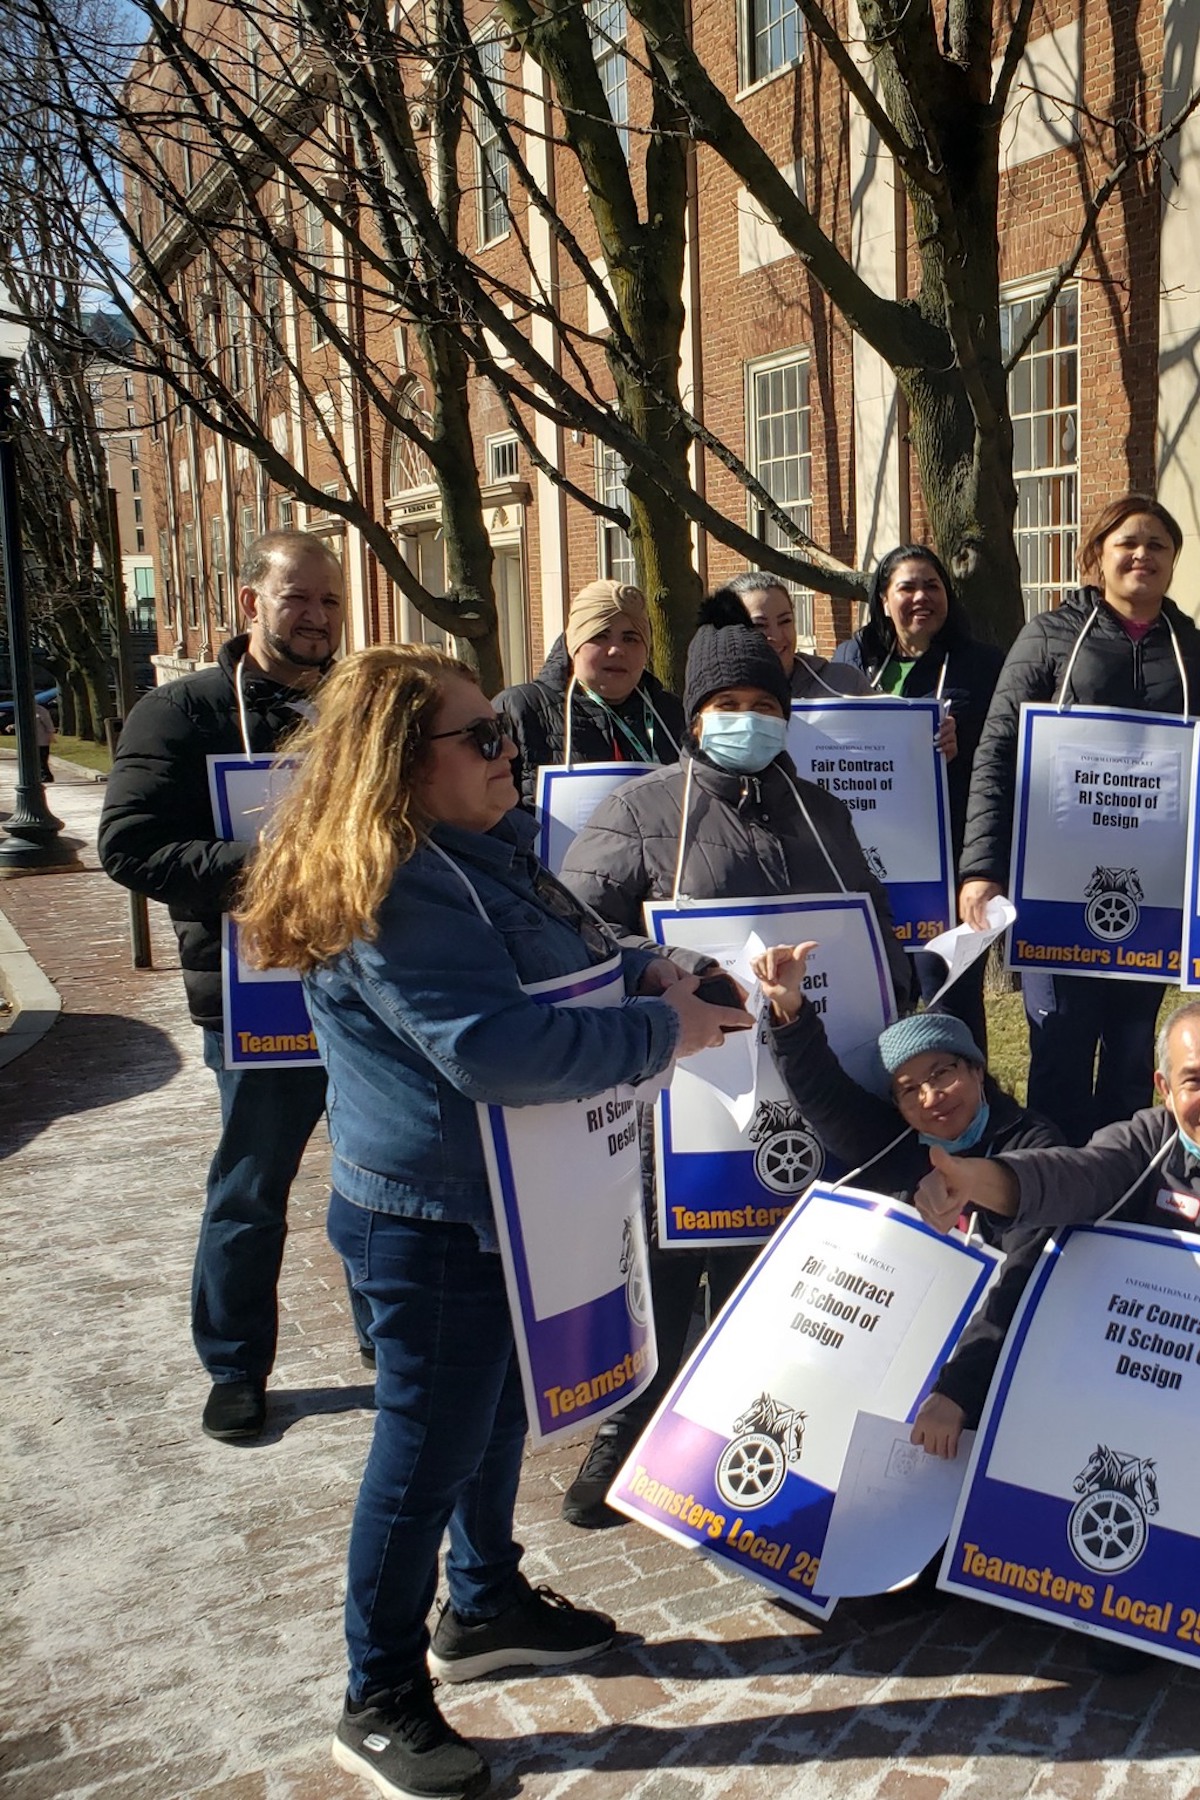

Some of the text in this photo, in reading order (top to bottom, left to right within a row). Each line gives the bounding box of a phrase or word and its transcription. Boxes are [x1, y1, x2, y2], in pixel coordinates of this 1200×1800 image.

[811, 758, 894, 772] Fair Contract
[1081, 755, 1130, 765] INFORMATIONAL
[817, 778, 893, 791] RI School of
[1075, 770, 1161, 789] Fair Contract
[840, 797, 876, 811] esign
[1079, 790, 1158, 809] RI School of
[1092, 811, 1139, 829] Design
[917, 921, 945, 939] 251
[1016, 940, 1111, 964] Teamsters
[1116, 946, 1162, 968] Local
[237, 1031, 318, 1053] Teamst
[586, 1106, 604, 1133] RI
[607, 1120, 637, 1157] Desig
[868, 1257, 896, 1275] PICKET
[801, 1255, 895, 1308] Fair Contract
[1125, 1277, 1191, 1300] INFORMATIONAL
[790, 1280, 881, 1332] RI School of
[1107, 1294, 1145, 1319] Fair
[790, 1311, 845, 1349] Design
[1104, 1321, 1127, 1344] RI
[1128, 1327, 1195, 1362] School
[543, 1342, 649, 1418] Teamster
[1116, 1354, 1183, 1390] Design
[628, 1465, 821, 1587] Teamsters Local 25
[1074, 1496, 1097, 1538] International
[1097, 1492, 1135, 1511] Brotherhood
[961, 1542, 1096, 1610] Teamsters
[1101, 1584, 1173, 1633] Local
